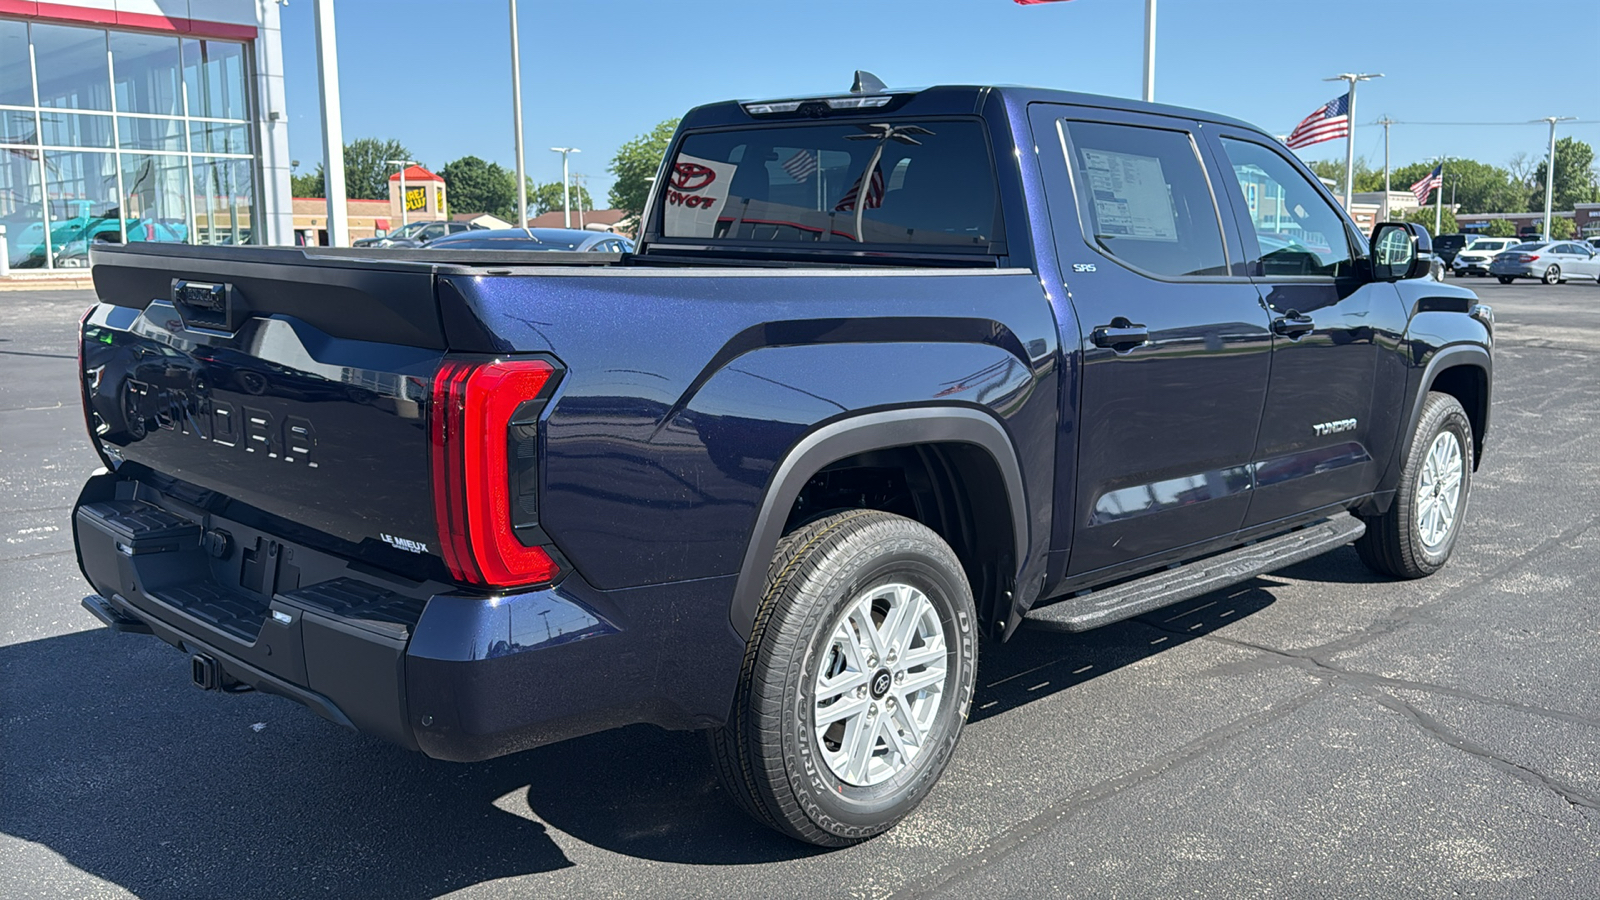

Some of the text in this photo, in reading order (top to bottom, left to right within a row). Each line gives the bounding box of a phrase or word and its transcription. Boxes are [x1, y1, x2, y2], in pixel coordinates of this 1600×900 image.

[405, 188, 425, 202] IRES
[405, 197, 426, 211] PLUS
[126, 377, 319, 468] TUNDRA
[1312, 417, 1358, 437] TUNDRA
[380, 532, 429, 553] LE MIEUX
